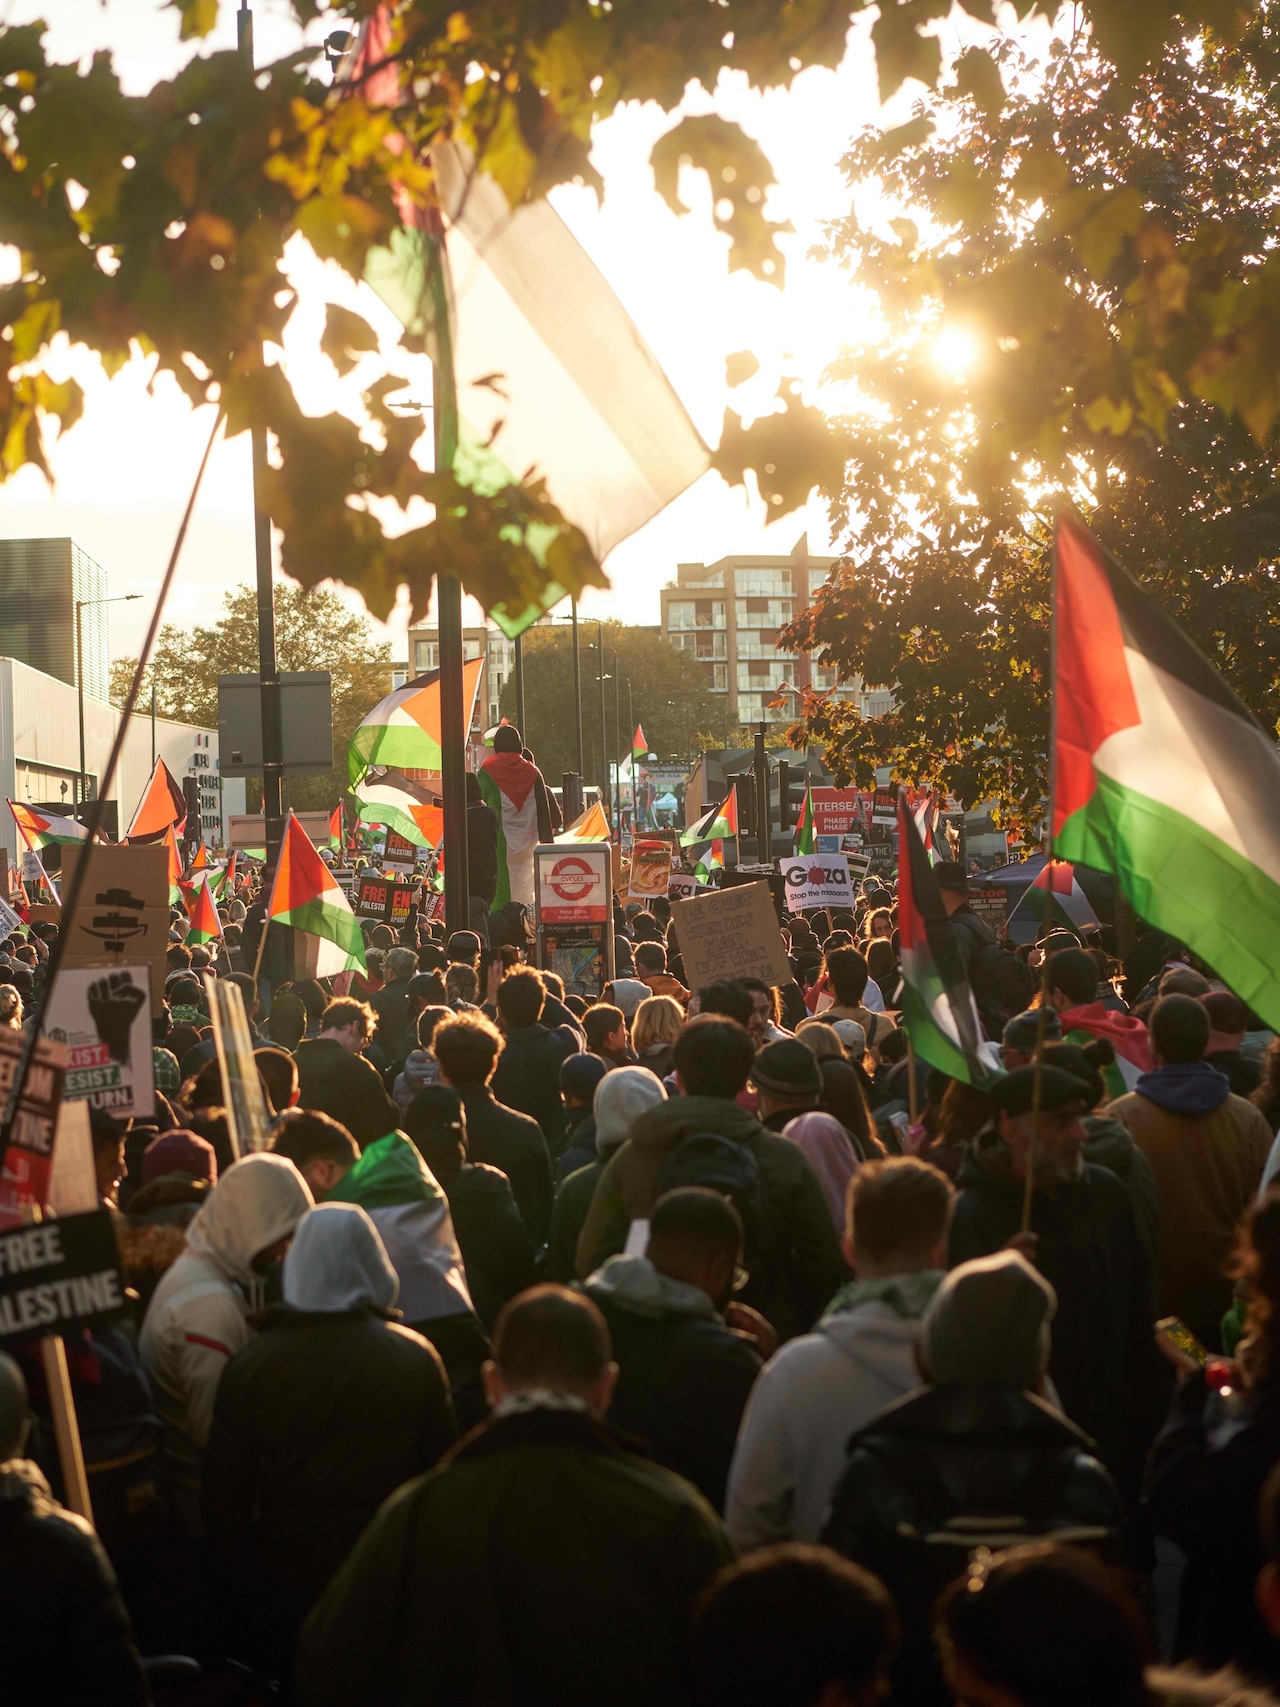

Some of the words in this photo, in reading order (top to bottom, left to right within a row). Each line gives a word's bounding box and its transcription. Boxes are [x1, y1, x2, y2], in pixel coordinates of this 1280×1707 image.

[798, 801, 858, 811] BTTERSEA
[388, 848, 413, 857] PALESTINE
[786, 865, 847, 887] Gza
[393, 890, 413, 908] EN
[790, 892, 807, 901] Stop
[391, 907, 410, 917] ISRA
[68, 1047, 109, 1067] XIST.
[66, 1067, 121, 1090] ESIST.
[0, 1268, 124, 1336] LESTINE
